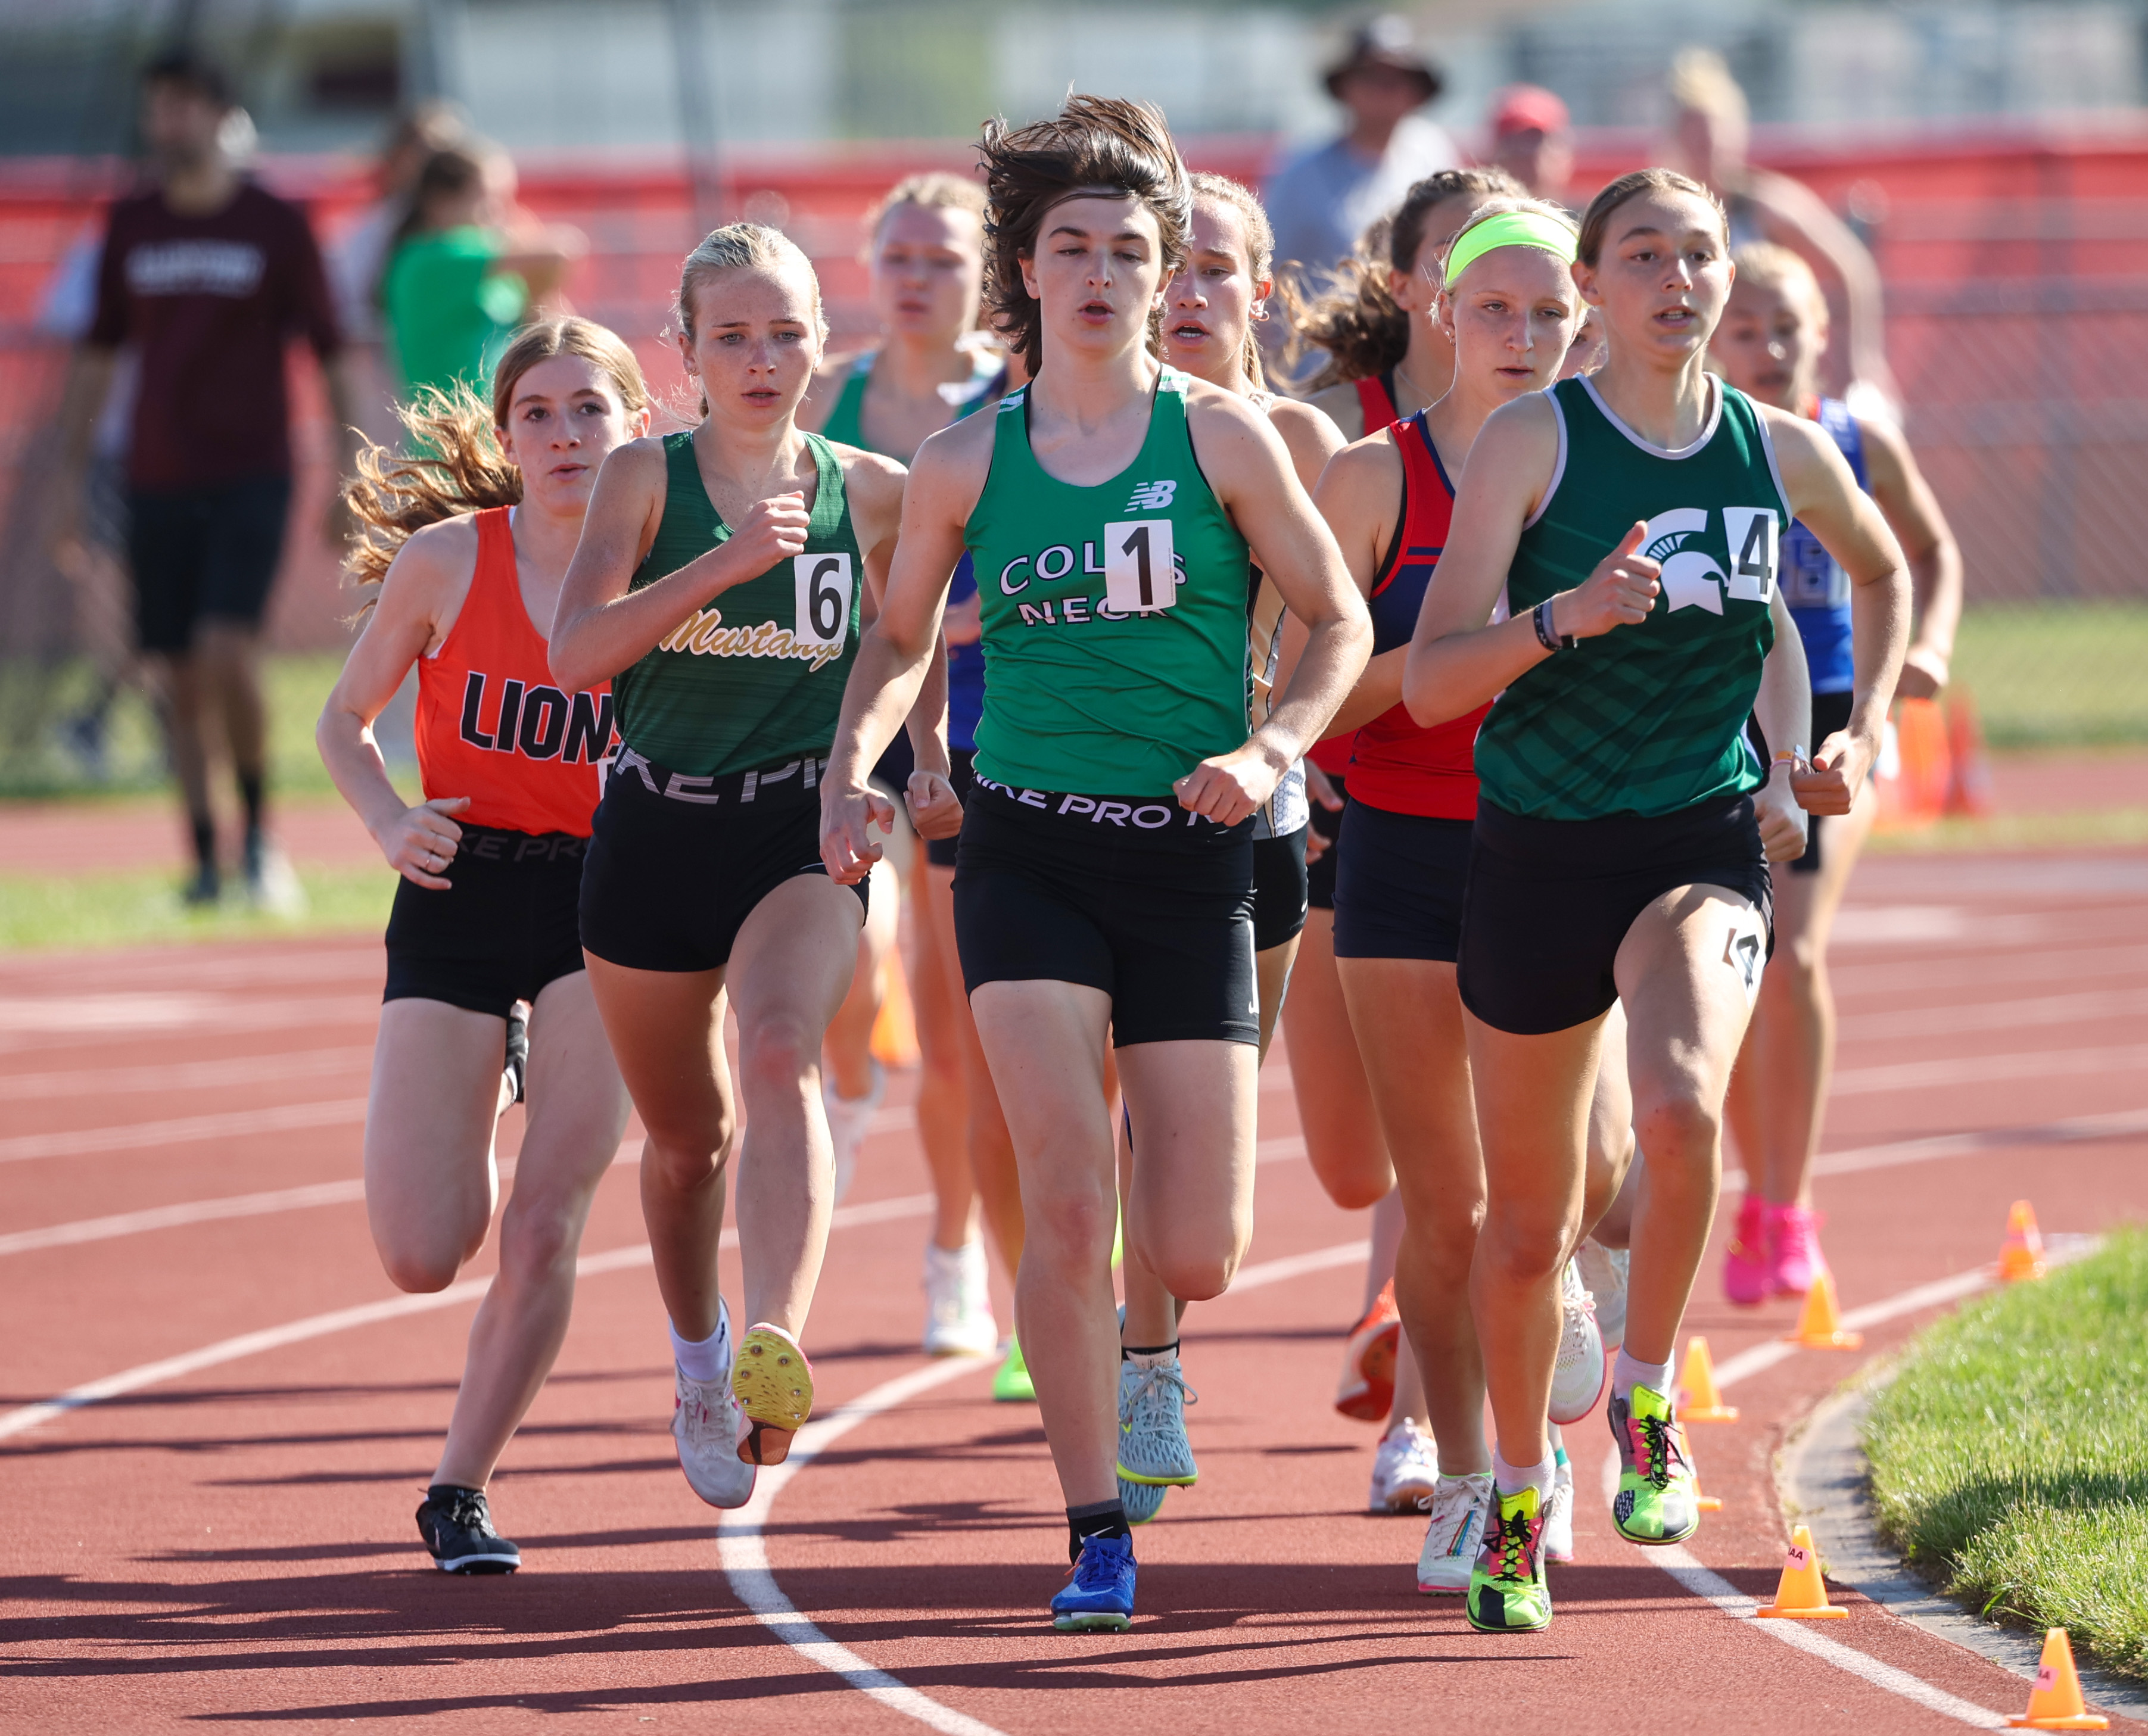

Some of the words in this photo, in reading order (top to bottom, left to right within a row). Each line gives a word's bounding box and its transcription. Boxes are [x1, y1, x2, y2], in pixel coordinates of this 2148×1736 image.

[999, 540, 1188, 597] COLS
[1121, 526, 1153, 606] 1
[1738, 514, 1772, 595] 4
[809, 558, 842, 640] 6
[460, 670, 623, 765] LION
[513, 836, 585, 862] PR
[1056, 793, 1172, 829] PRO
